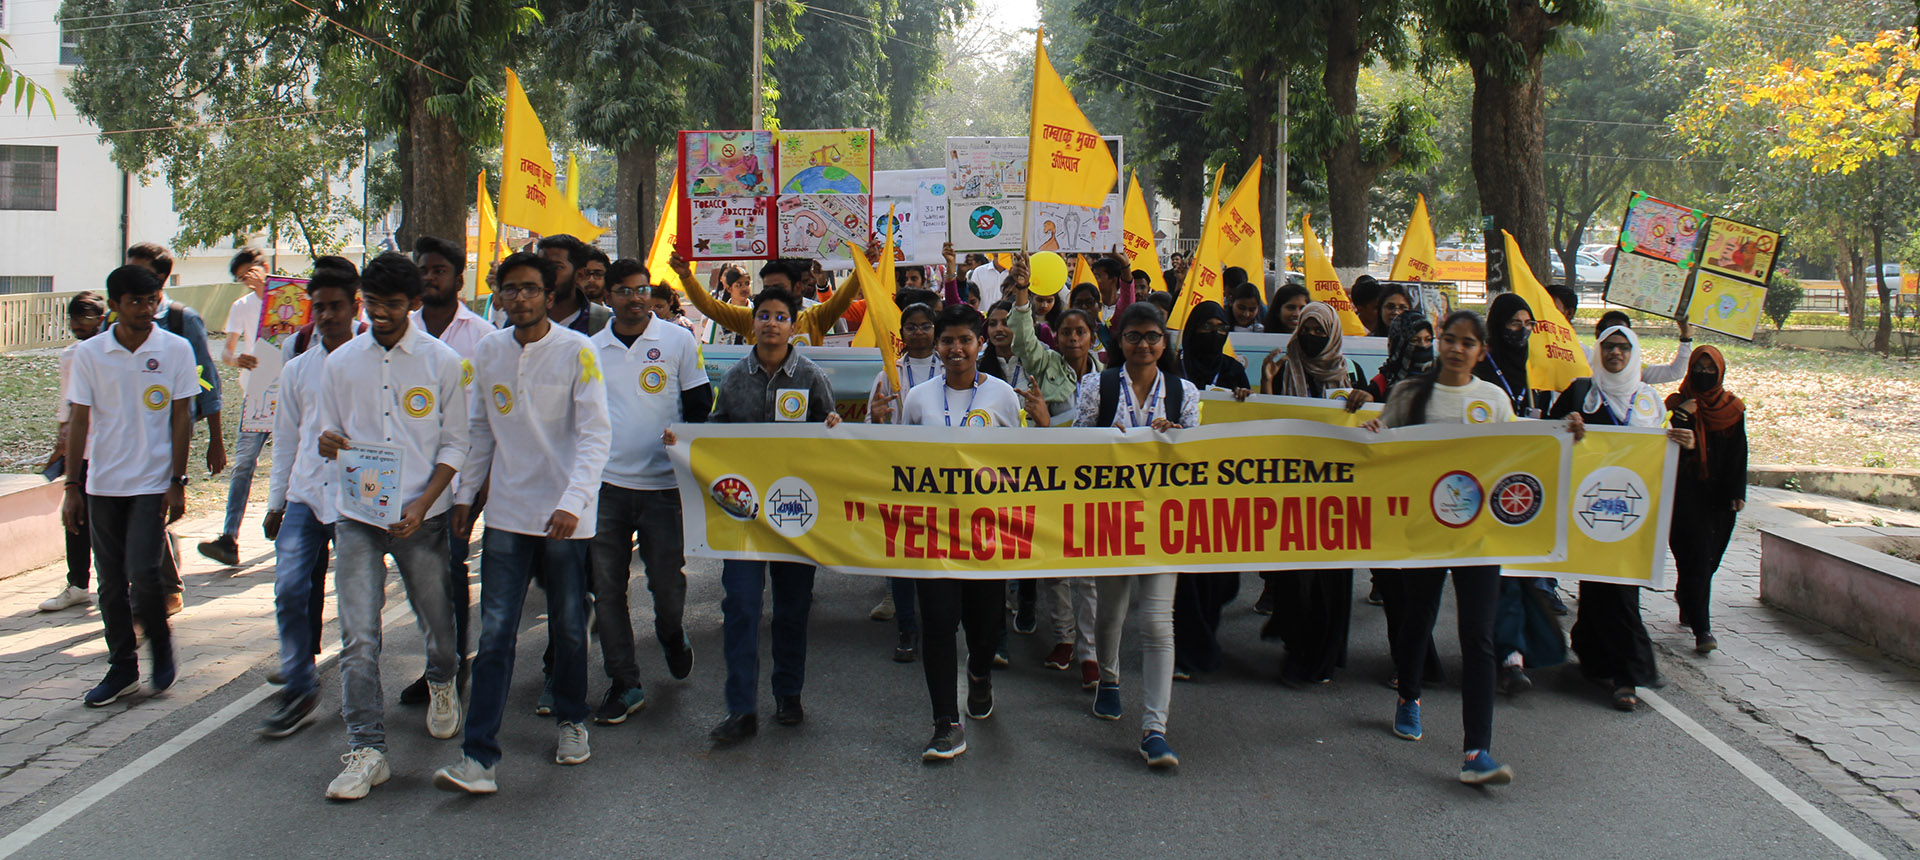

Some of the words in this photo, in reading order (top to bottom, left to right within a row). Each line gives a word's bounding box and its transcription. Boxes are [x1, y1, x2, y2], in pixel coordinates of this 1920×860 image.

[1076, 131, 1098, 152] मुक्त
[1051, 150, 1081, 173] अभियान
[693, 199, 727, 209] TOBACCO
[722, 207, 764, 216] ADICTION
[891, 465, 1067, 495] NATIONAL
[1073, 461, 1210, 491] SERVICE
[1216, 458, 1356, 486] SCHEME
[364, 483, 376, 493] NO
[878, 504, 1036, 562] YELLOW
[1062, 500, 1147, 559] LINE
[1159, 496, 1373, 555] CAMPAIGN
